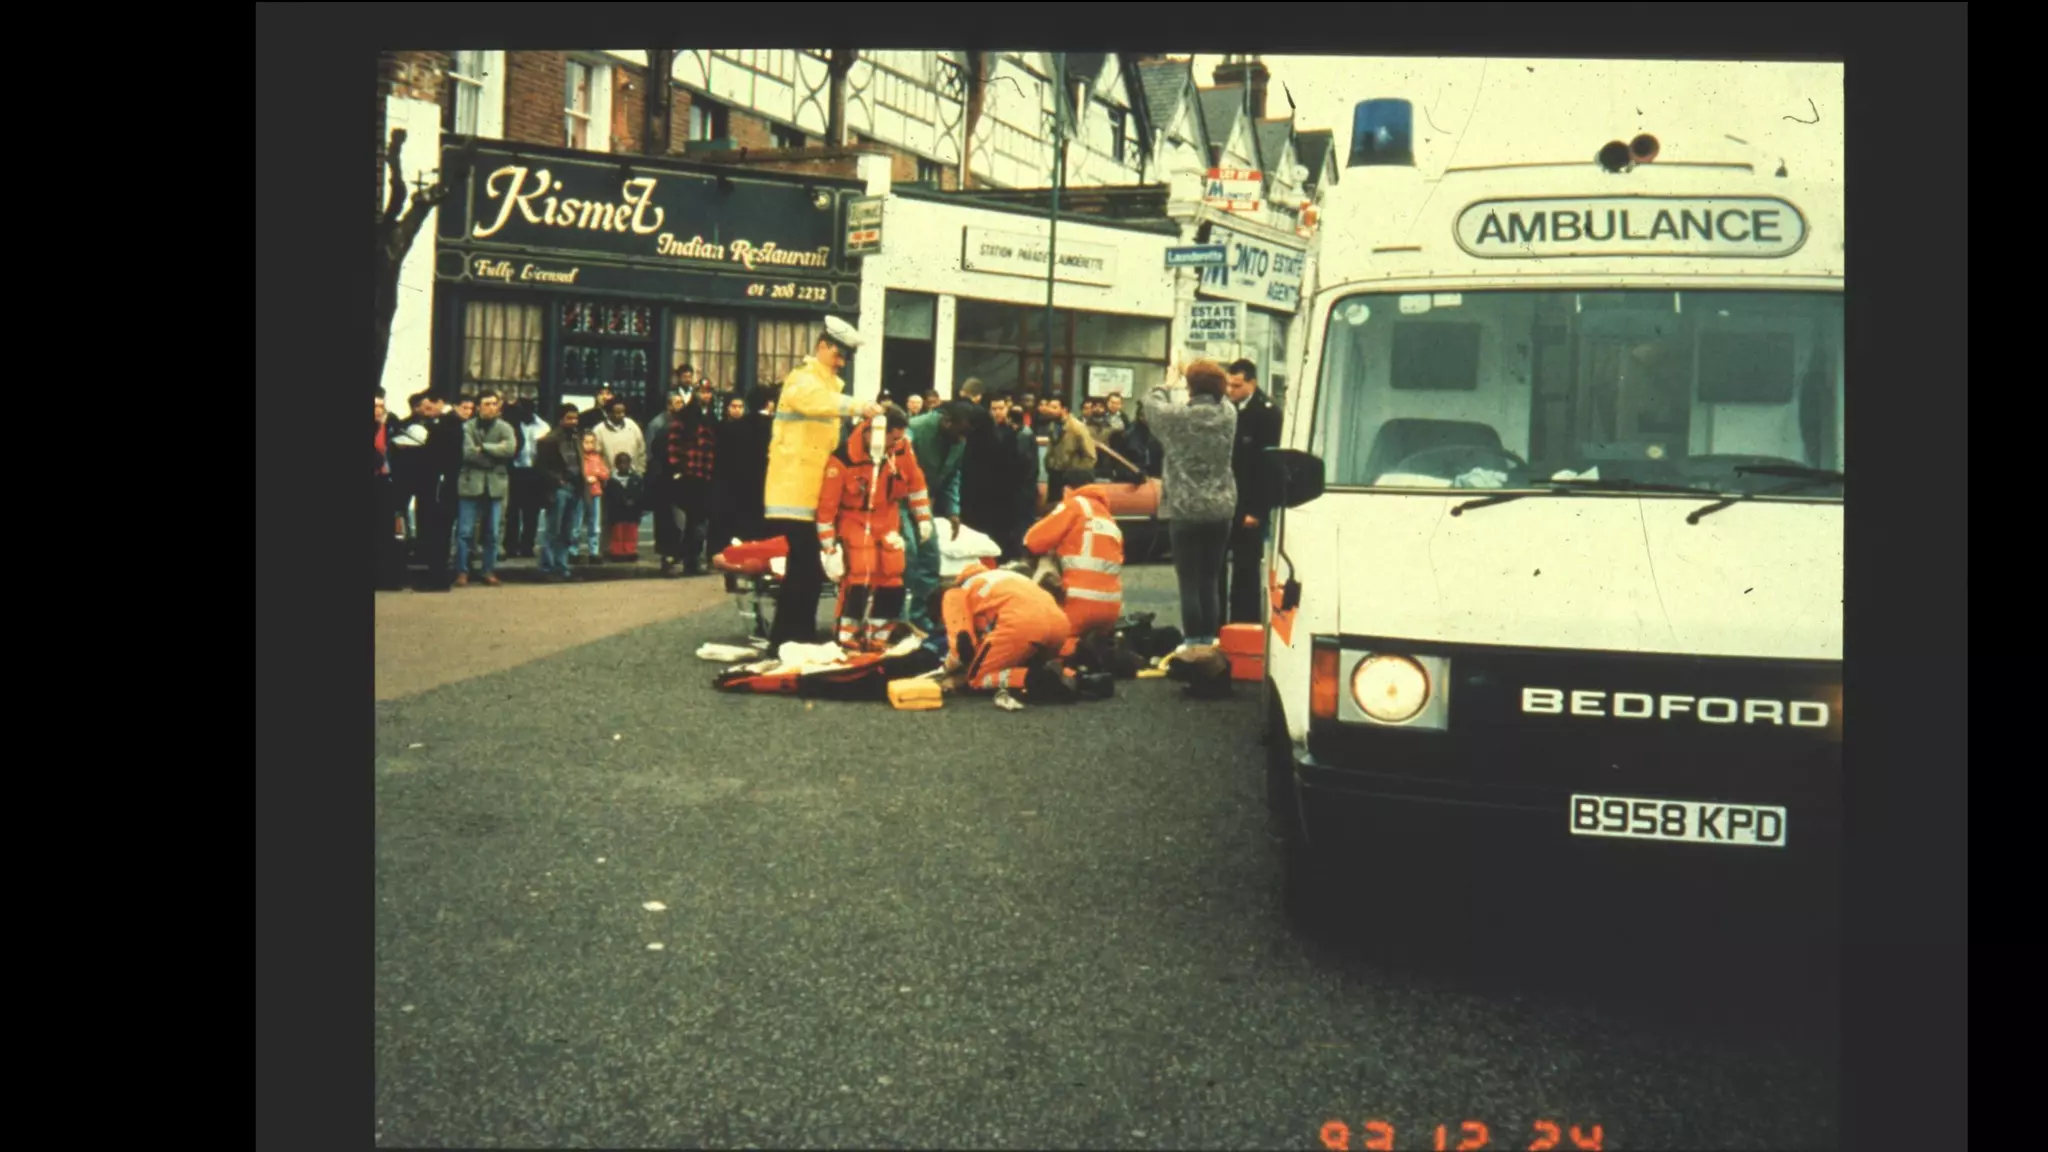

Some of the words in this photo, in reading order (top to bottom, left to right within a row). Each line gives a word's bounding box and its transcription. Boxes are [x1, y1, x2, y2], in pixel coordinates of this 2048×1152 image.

[472, 164, 665, 239] Kismet
[1475, 207, 1783, 245] AMBULANCE
[656, 233, 725, 260] Indian
[730, 239, 831, 270] Restaurant
[980, 243, 1012, 259] STATION
[1017, 248, 1049, 263] PARADE
[1055, 252, 1104, 271] AUNDERETTE
[474, 259, 515, 284] Fully
[520, 263, 579, 284] Licensed
[747, 283, 765, 297] 01
[770, 282, 796, 299] 208
[1190, 318, 1236, 329] AGENTS
[1191, 306, 1236, 317] ESTATE
[1522, 687, 1829, 727] BEDFORD
[1574, 798, 1687, 837] B958
[1697, 805, 1783, 843] KPD
